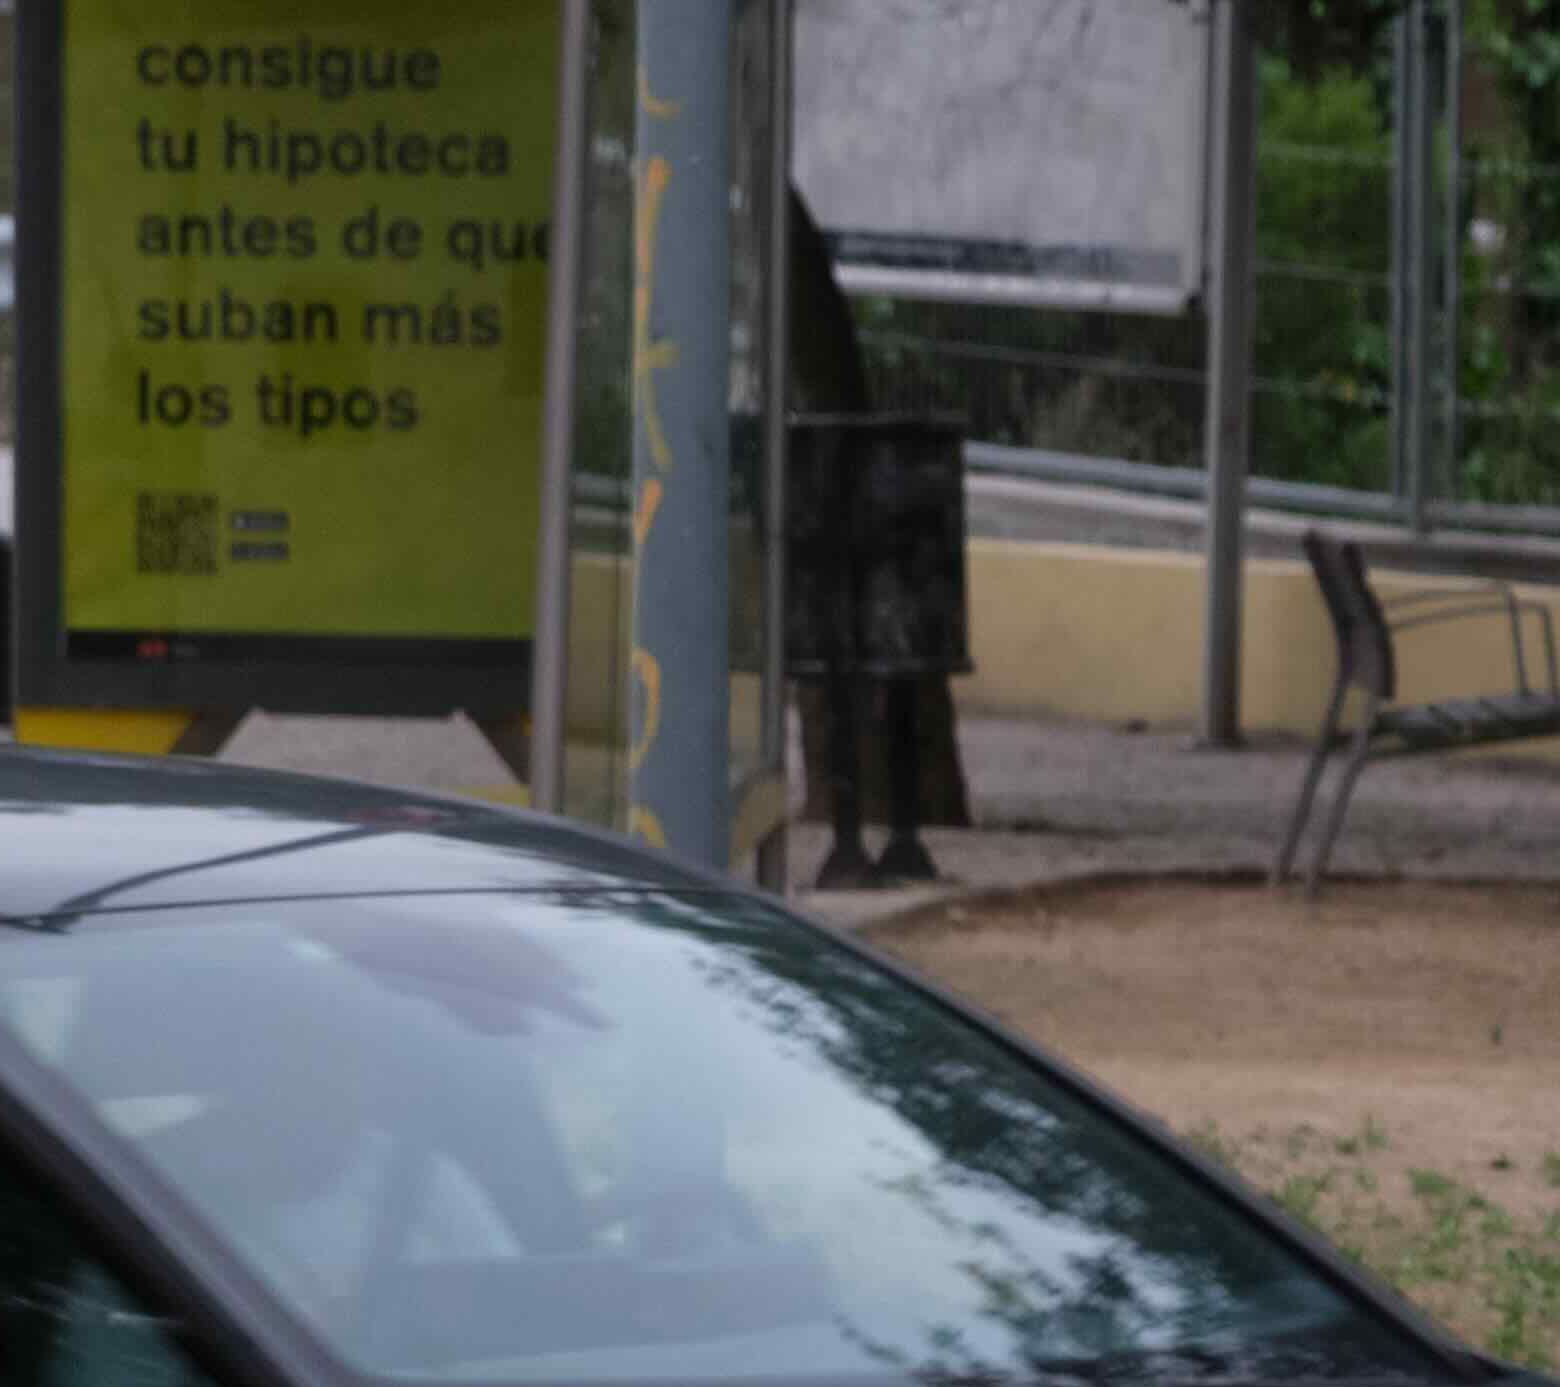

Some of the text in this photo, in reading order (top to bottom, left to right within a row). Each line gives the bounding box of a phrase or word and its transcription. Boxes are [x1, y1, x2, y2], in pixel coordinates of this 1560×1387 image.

[135, 36, 441, 99] consigue
[135, 117, 510, 185] tu hipoteca
[135, 205, 317, 259] antes
[341, 205, 424, 260] de
[137, 287, 501, 346] suban más
[135, 368, 420, 437] los tipos
